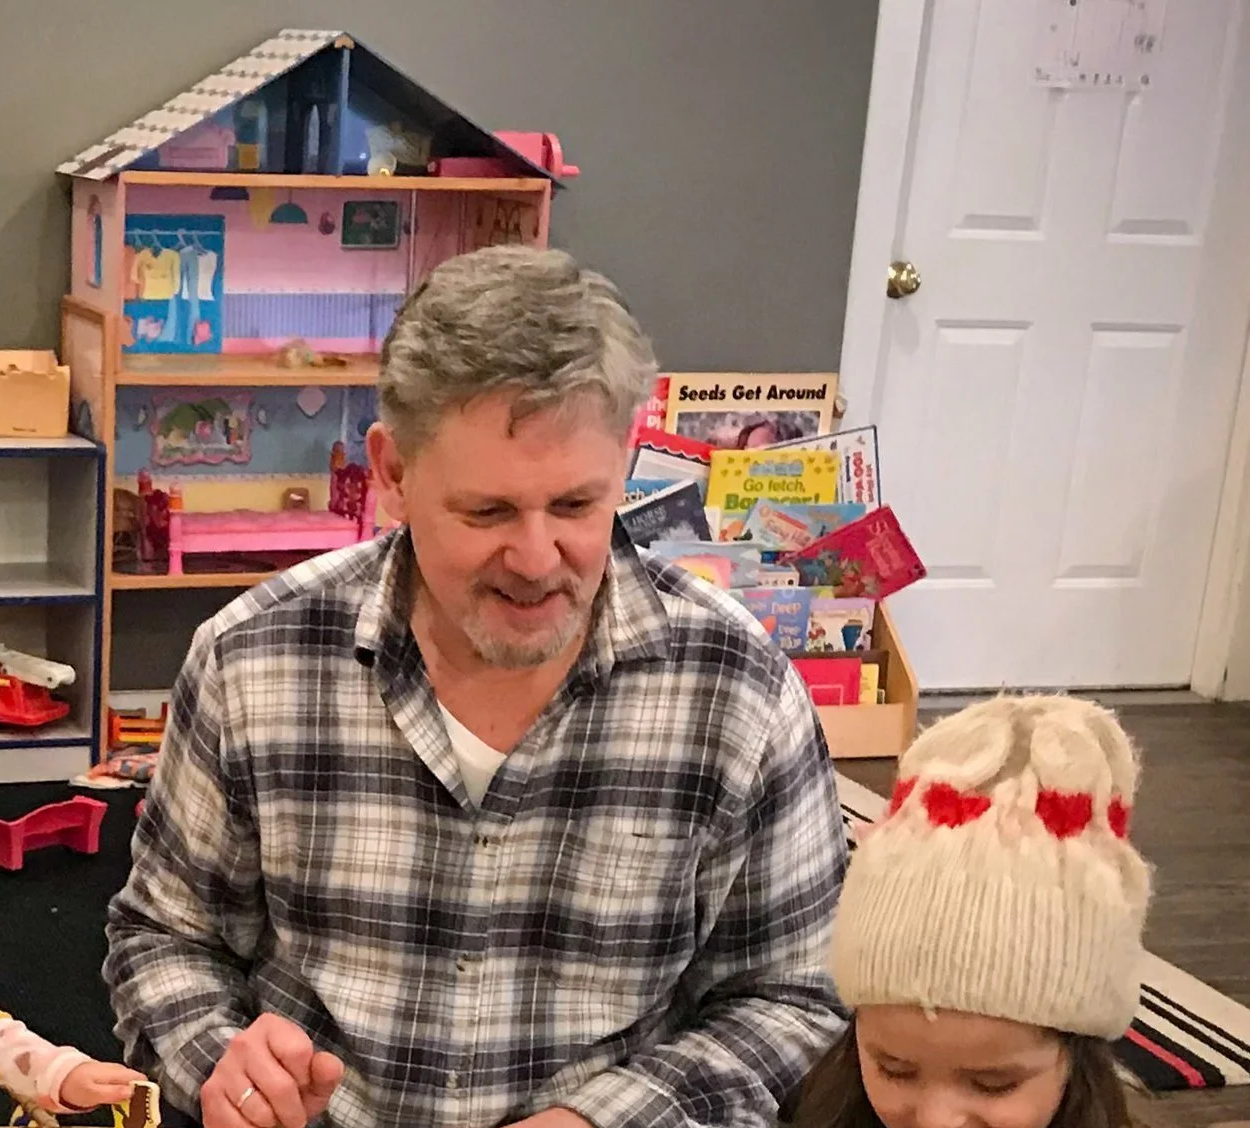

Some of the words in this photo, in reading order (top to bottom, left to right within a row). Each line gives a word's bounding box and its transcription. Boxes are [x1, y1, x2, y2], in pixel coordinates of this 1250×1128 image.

[678, 384, 726, 401] Seeds
[732, 384, 762, 401] Get
[766, 383, 827, 401] Around
[743, 478, 764, 492] Go
[724, 493, 820, 510] Bocer!
